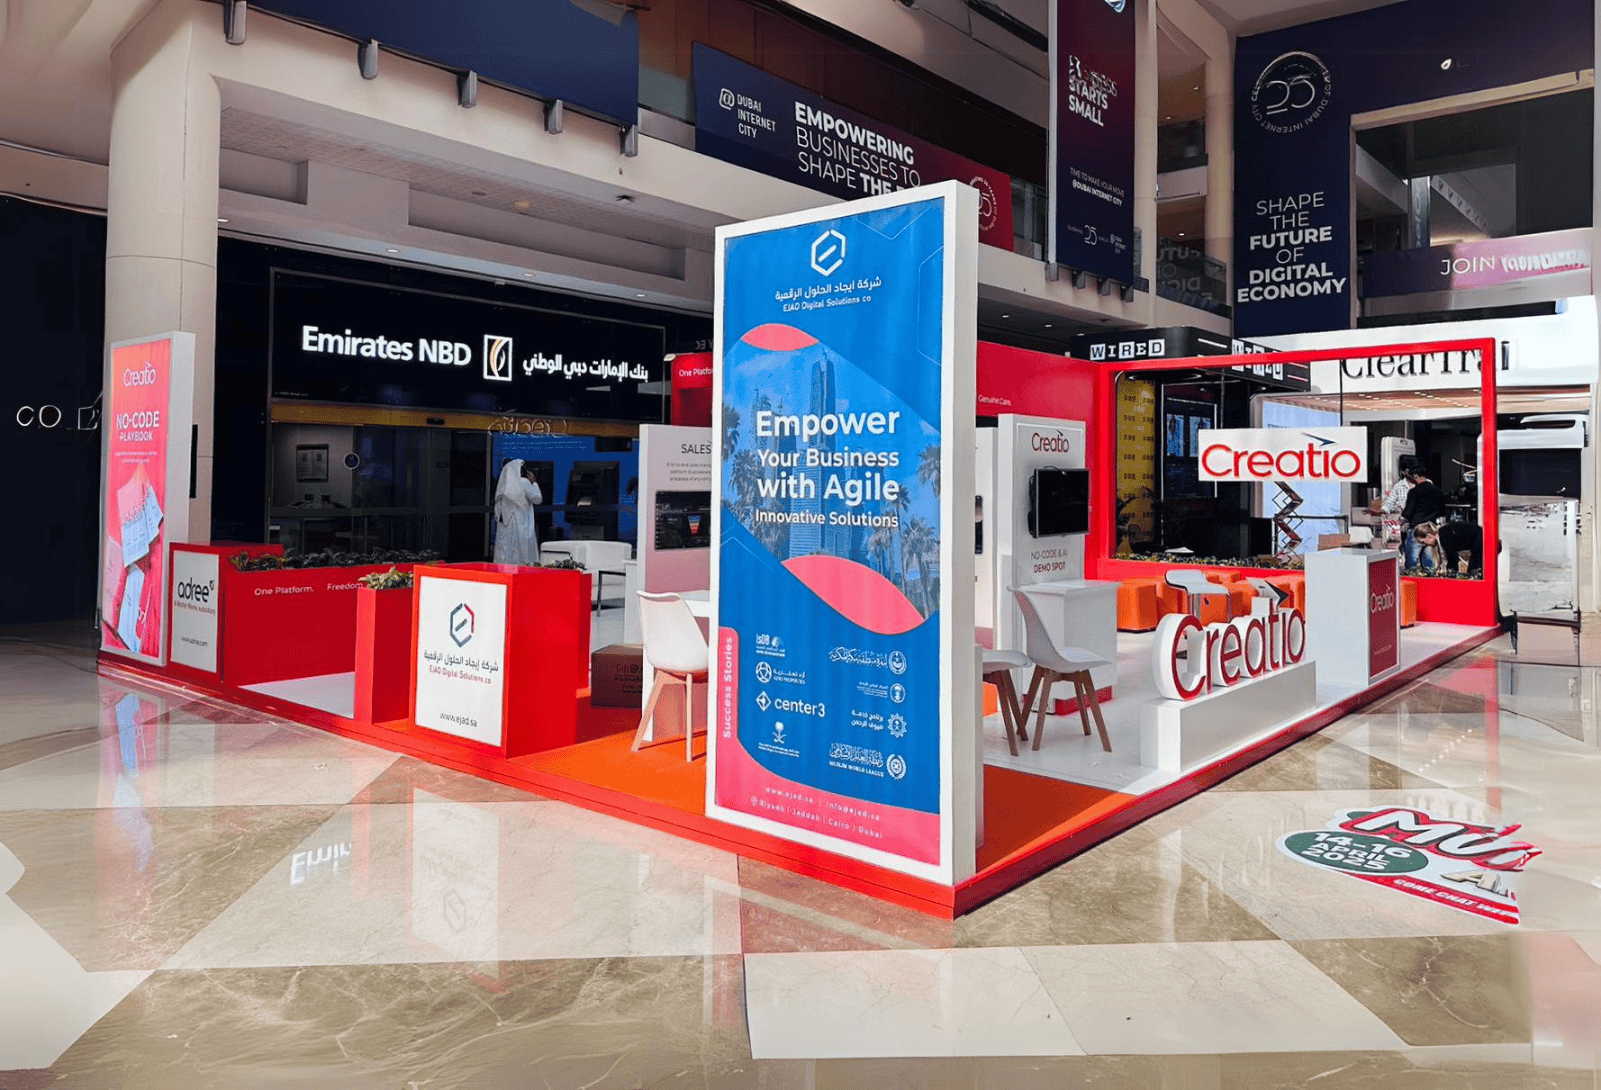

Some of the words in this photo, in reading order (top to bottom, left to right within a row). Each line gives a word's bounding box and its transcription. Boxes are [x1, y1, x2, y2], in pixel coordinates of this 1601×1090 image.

[737, 93, 761, 113] DUBAI
[1069, 94, 1104, 127] SMALL
[738, 109, 776, 132] INTERNET
[738, 122, 757, 138] CITY
[795, 101, 914, 165] EMPOWERING
[796, 126, 898, 180] BUSINESSES
[900, 165, 921, 188] TO
[798, 151, 855, 189] SHAPE
[860, 173, 892, 196] THE
[1255, 191, 1325, 216] SHAPE
[1269, 210, 1309, 231] THE
[1249, 226, 1332, 251] FUTURE
[1275, 246, 1304, 265] OF
[1440, 255, 1495, 275] JOIN
[856, 275, 882, 291] شركة
[1249, 261, 1333, 286] DIGITAL
[775, 287, 803, 302] الرقمية
[804, 284, 832, 299] الحلول
[1237, 278, 1346, 304] ECONOMY
[801, 300, 824, 311] Digital
[826, 296, 860, 308] Solutions
[302, 325, 413, 362] Emirates
[419, 338, 471, 366] NBD
[1089, 338, 1164, 361] WIRED
[522, 352, 562, 377] الوطني
[563, 361, 587, 380] دبي
[589, 360, 628, 382] الإمارات
[628, 362, 649, 383] بنك
[678, 368, 692, 377] One
[123, 363, 157, 388] Creatio
[116, 410, 160, 431] NO-CODE
[756, 409, 900, 442] Empower
[119, 430, 153, 442] PLAYBOOK
[1031, 431, 1069, 453] Creatio
[681, 443, 712, 454] SALES
[757, 448, 800, 467] Your
[806, 446, 900, 467] Business
[1201, 442, 1360, 479] Creatio
[756, 471, 815, 499] with
[823, 471, 900, 506] Agile
[755, 508, 826, 525] Innovative
[829, 510, 899, 528] Solutions
[1033, 562, 1050, 573] DEMO
[1051, 561, 1065, 571] SPOT
[178, 577, 210, 602] adree
[254, 588, 273, 596] One
[275, 585, 315, 595] Platform.
[424, 649, 443, 663] الرقمية
[444, 654, 464, 666] الحلول
[724, 637, 733, 682] Stories
[1170, 598, 1305, 702] Creatio
[442, 667, 459, 679] Digital
[459, 671, 483, 682] Solutions
[481, 660, 499, 674] شركة
[722, 685, 732, 738] Success
[774, 698, 826, 718] center3
[440, 713, 477, 727] www.ejad.sa
[829, 760, 848, 769] MUSLIM
[848, 763, 865, 773] WORLD
[865, 766, 884, 777] LEAGUE
[765, 787, 813, 804] www.ejad.sa
[826, 802, 880, 822] info@ejad.sa
[759, 799, 785, 813] Riyadh
[792, 808, 821, 823] Jeddah
[828, 818, 851, 830] Cairo
[858, 826, 883, 839] Dubai
[1309, 843, 1390, 863] APRIL
[1314, 832, 1413, 860] 14-16
[1300, 849, 1392, 871] 2025
[1392, 878, 1436, 895] COME
[1437, 890, 1476, 906] CHAT
